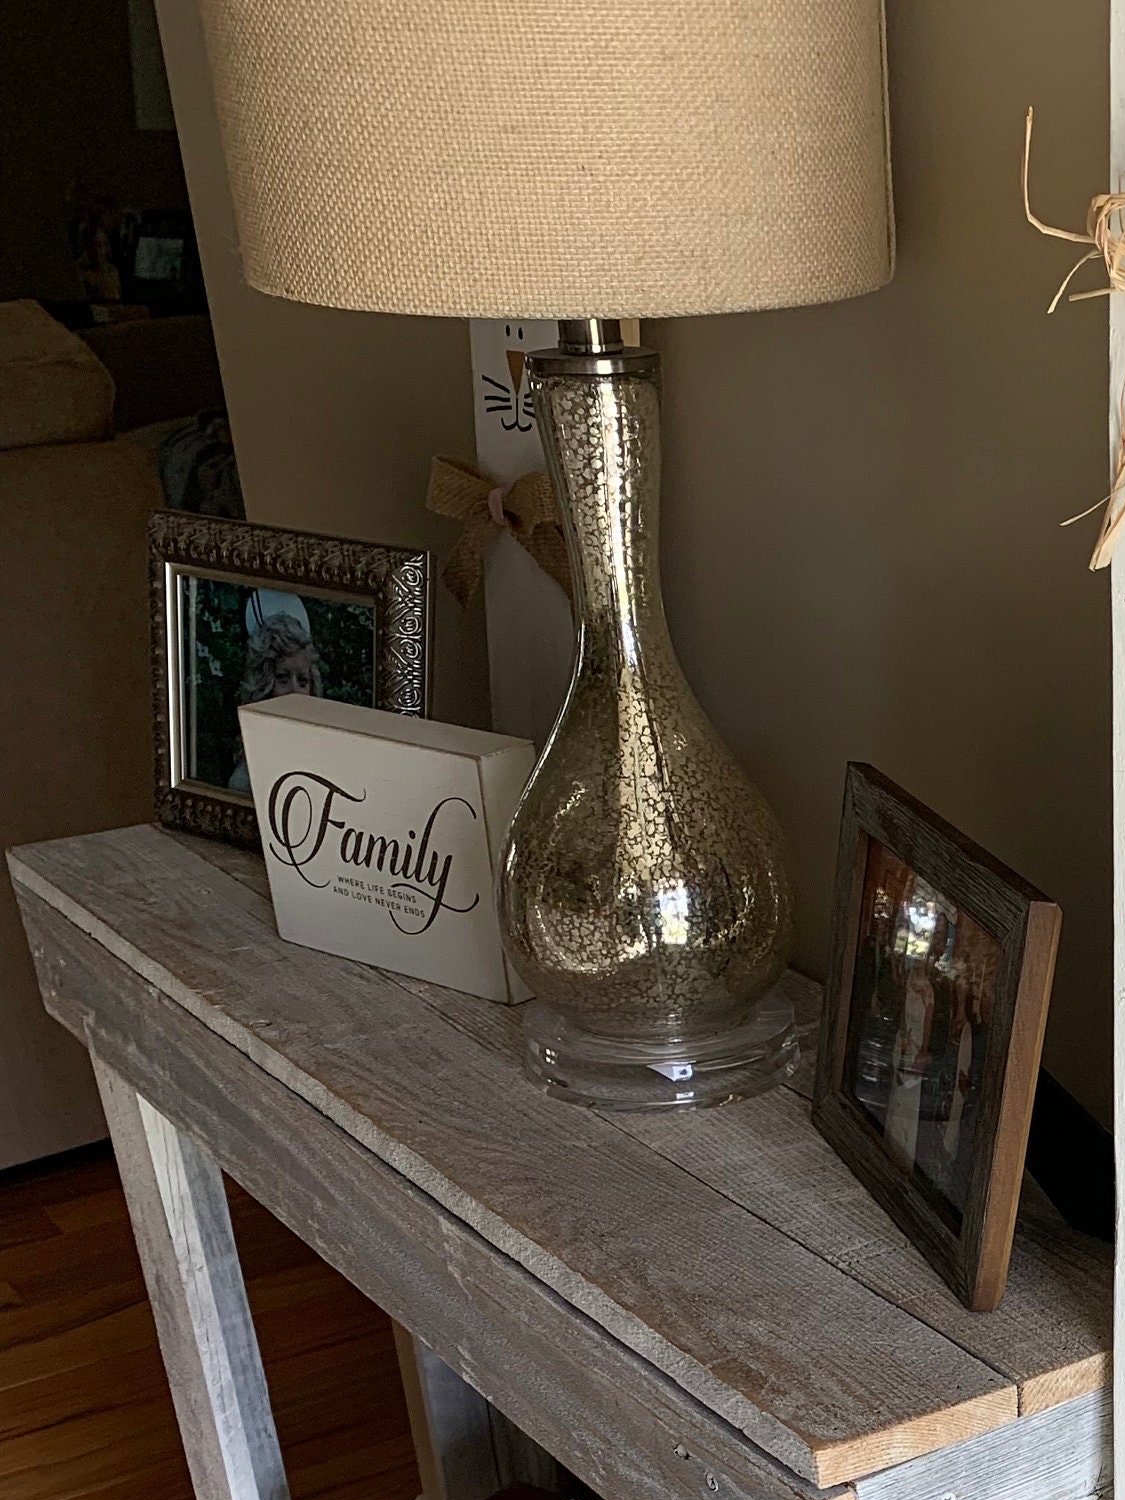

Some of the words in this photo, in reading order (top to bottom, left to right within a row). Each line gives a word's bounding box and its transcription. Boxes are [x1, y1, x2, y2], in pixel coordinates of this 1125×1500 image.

[268, 771, 480, 935] Family
[333, 886, 349, 897] AND
[351, 892, 372, 904] LOVE
[375, 897, 401, 912] NEVER
[404, 905, 425, 918] ENDS
[337, 876, 365, 890] WHERE
[367, 883, 385, 895] LIFE
[387, 888, 417, 904] BEGINS
